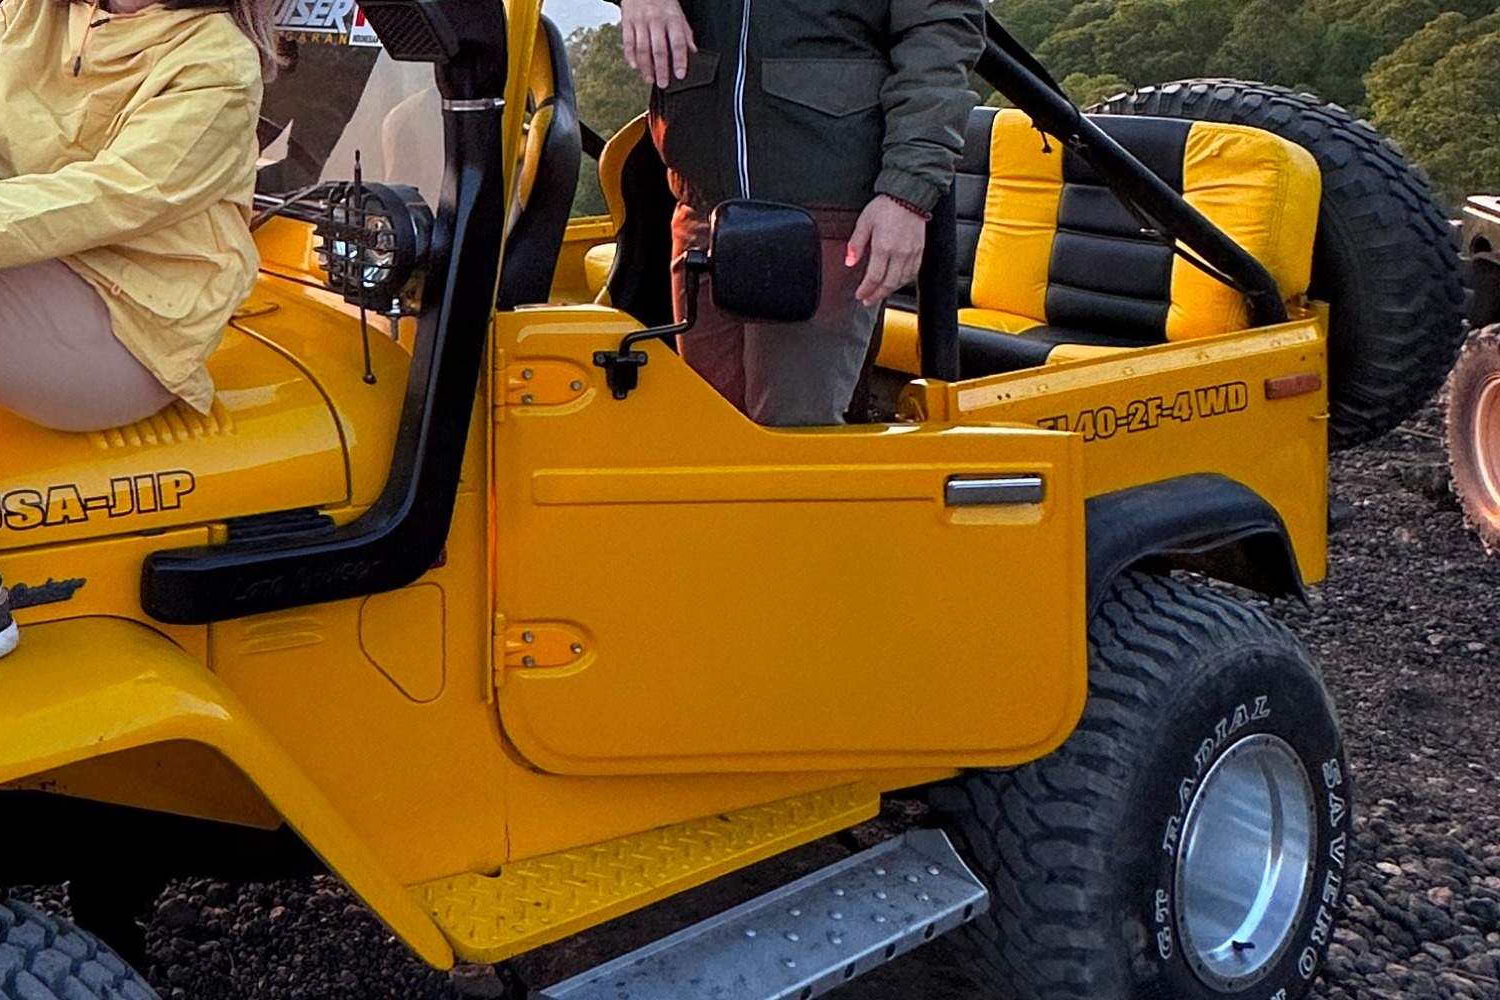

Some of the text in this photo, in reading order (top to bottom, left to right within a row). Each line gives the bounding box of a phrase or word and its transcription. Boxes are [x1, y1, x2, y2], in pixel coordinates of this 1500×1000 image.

[1194, 380, 1249, 418] WD
[1155, 695, 1272, 960] GT RADIAL
[1298, 757, 1347, 980] SAVERO
